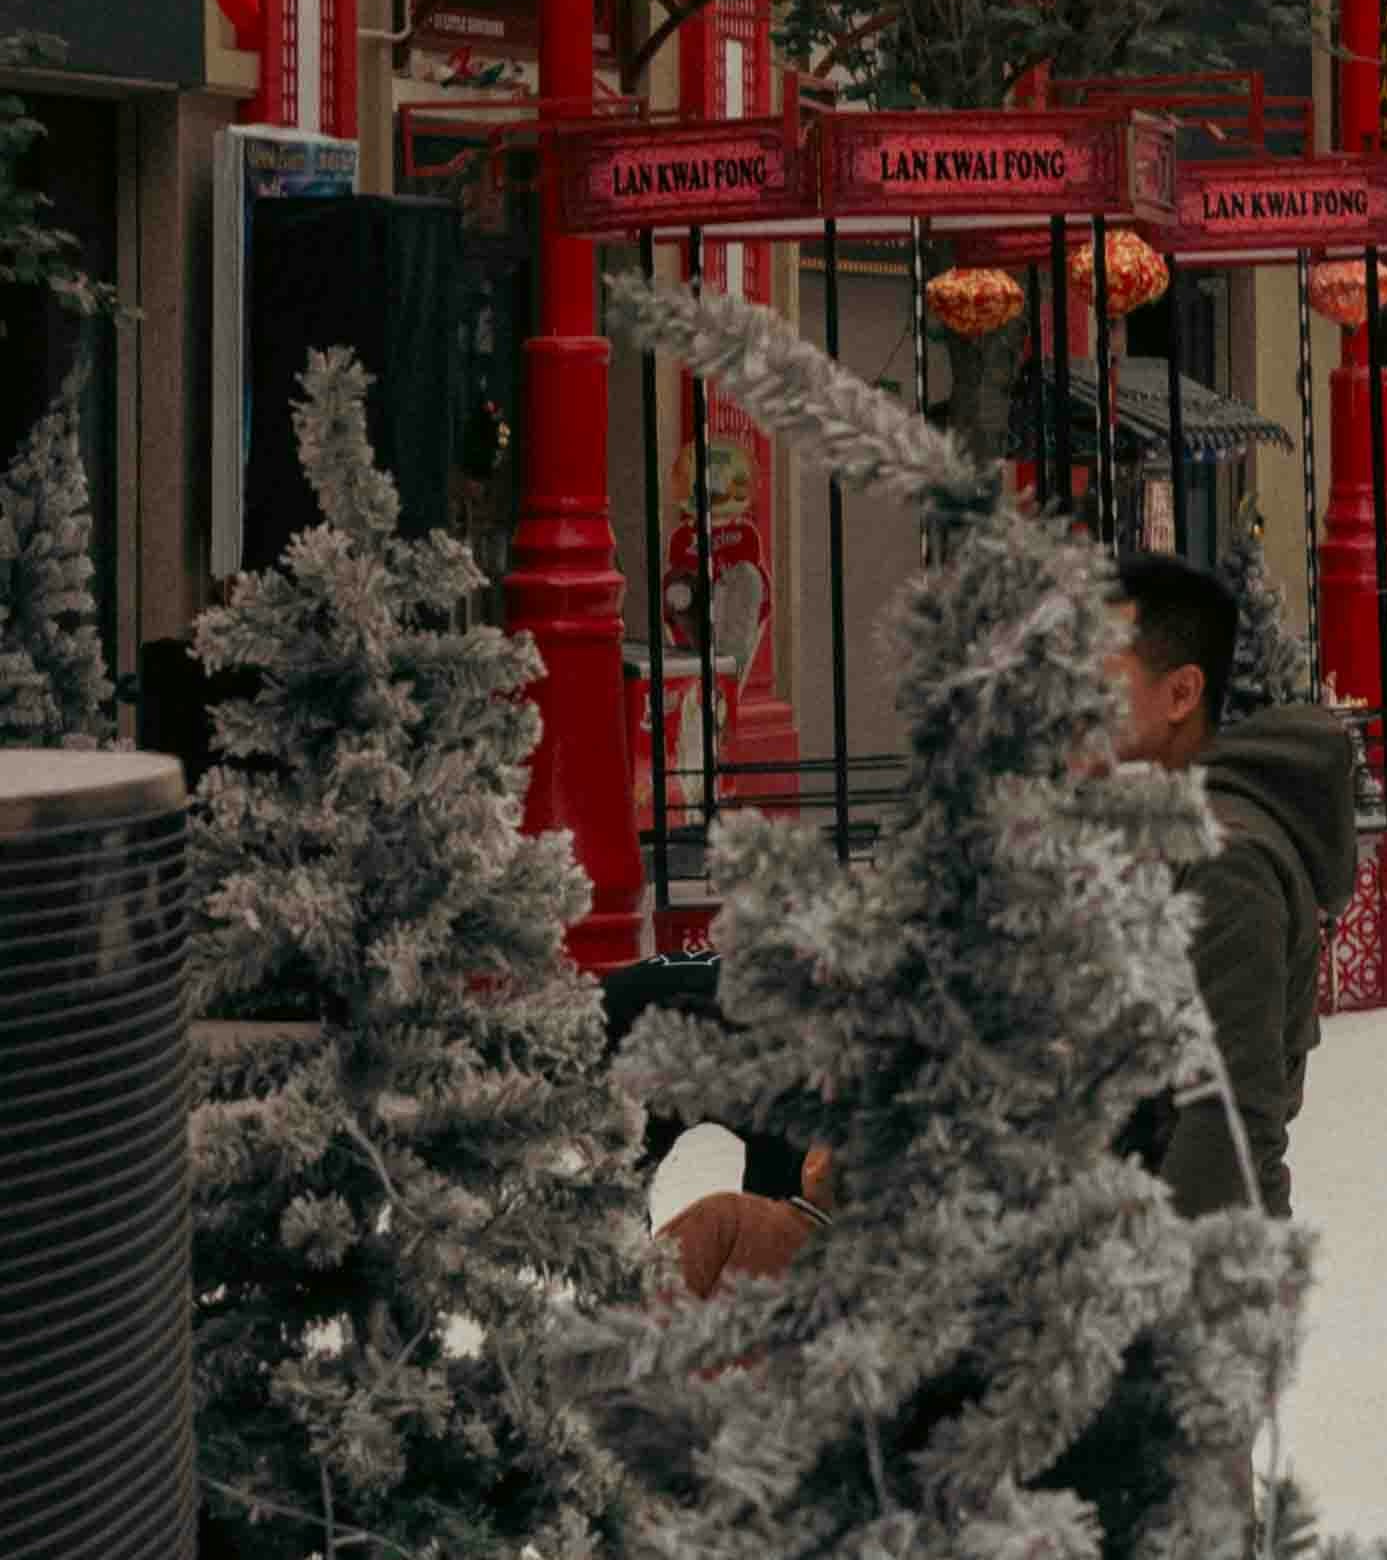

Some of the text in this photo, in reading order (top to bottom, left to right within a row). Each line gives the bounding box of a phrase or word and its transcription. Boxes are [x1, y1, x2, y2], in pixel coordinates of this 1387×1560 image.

[613, 155, 767, 195] LAN KWAI FONG
[881, 150, 1066, 181] LAN KWAI FONG
[1203, 188, 1369, 220] LAN KWAI FONG
